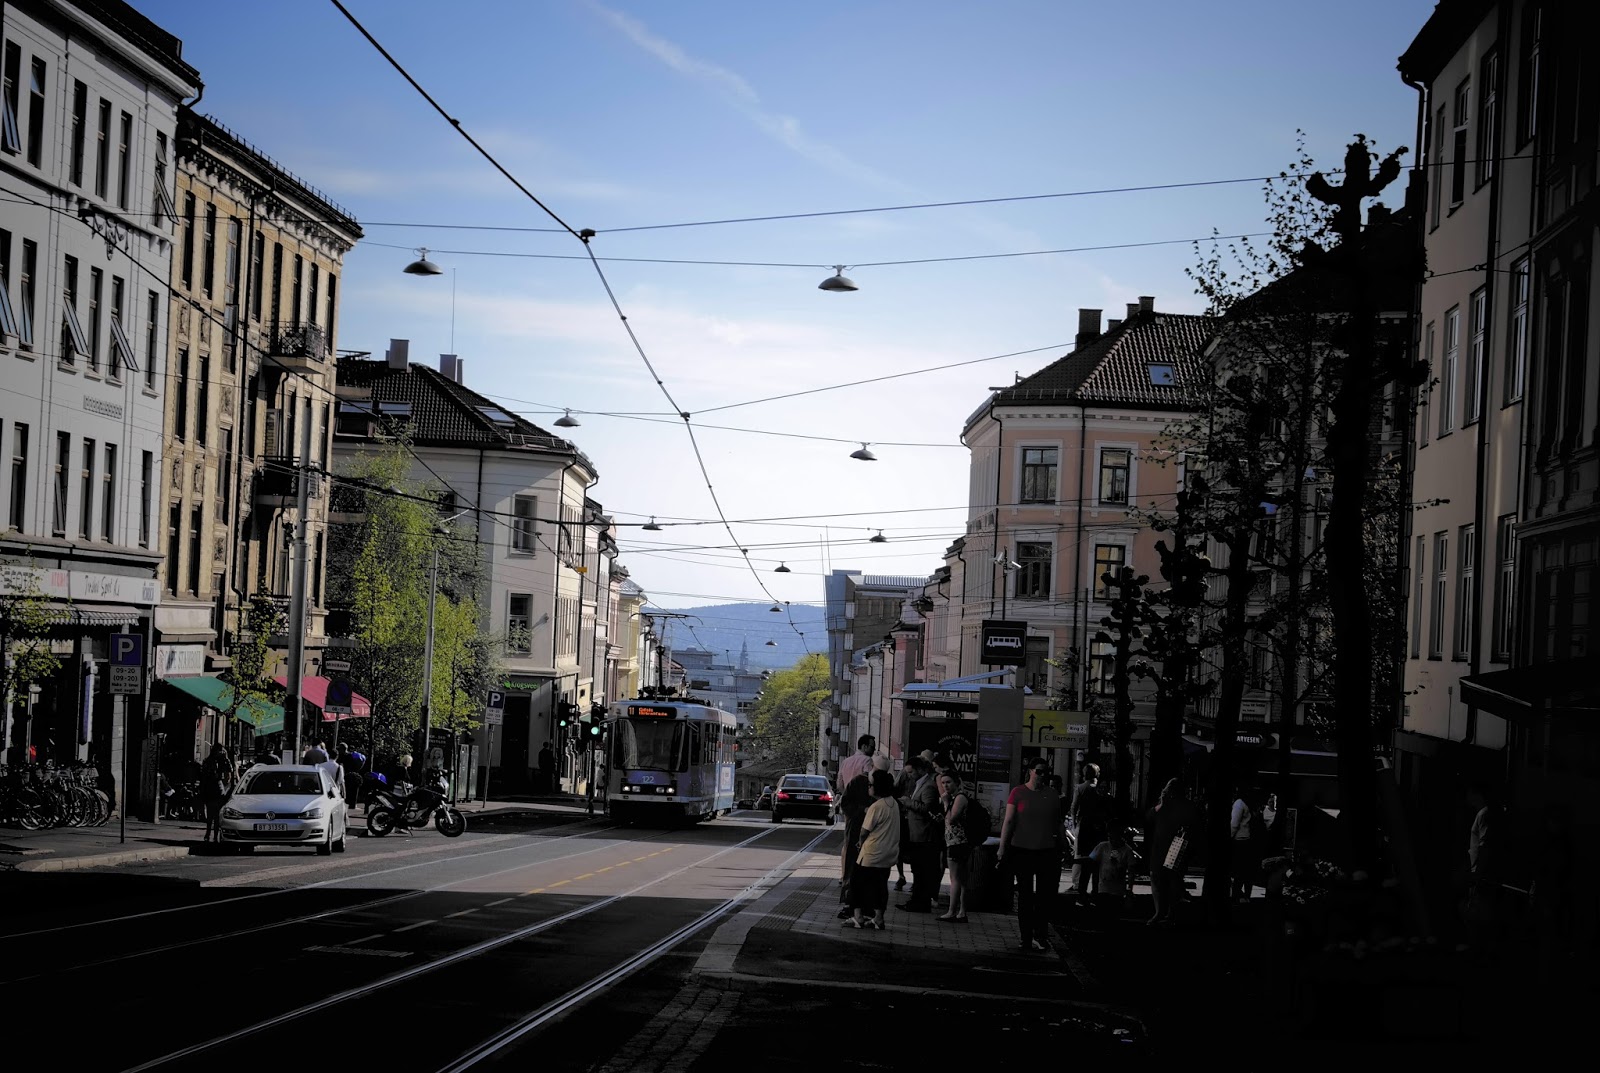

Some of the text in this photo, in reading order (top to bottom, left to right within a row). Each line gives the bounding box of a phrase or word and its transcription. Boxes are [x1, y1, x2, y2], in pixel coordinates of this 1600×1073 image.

[118, 638, 135, 662] P
[490, 693, 501, 706] P
[628, 706, 635, 716] 11
[1236, 735, 1260, 744] ARVESEN
[953, 762, 974, 772] VIL!
[642, 775, 654, 784] 122
